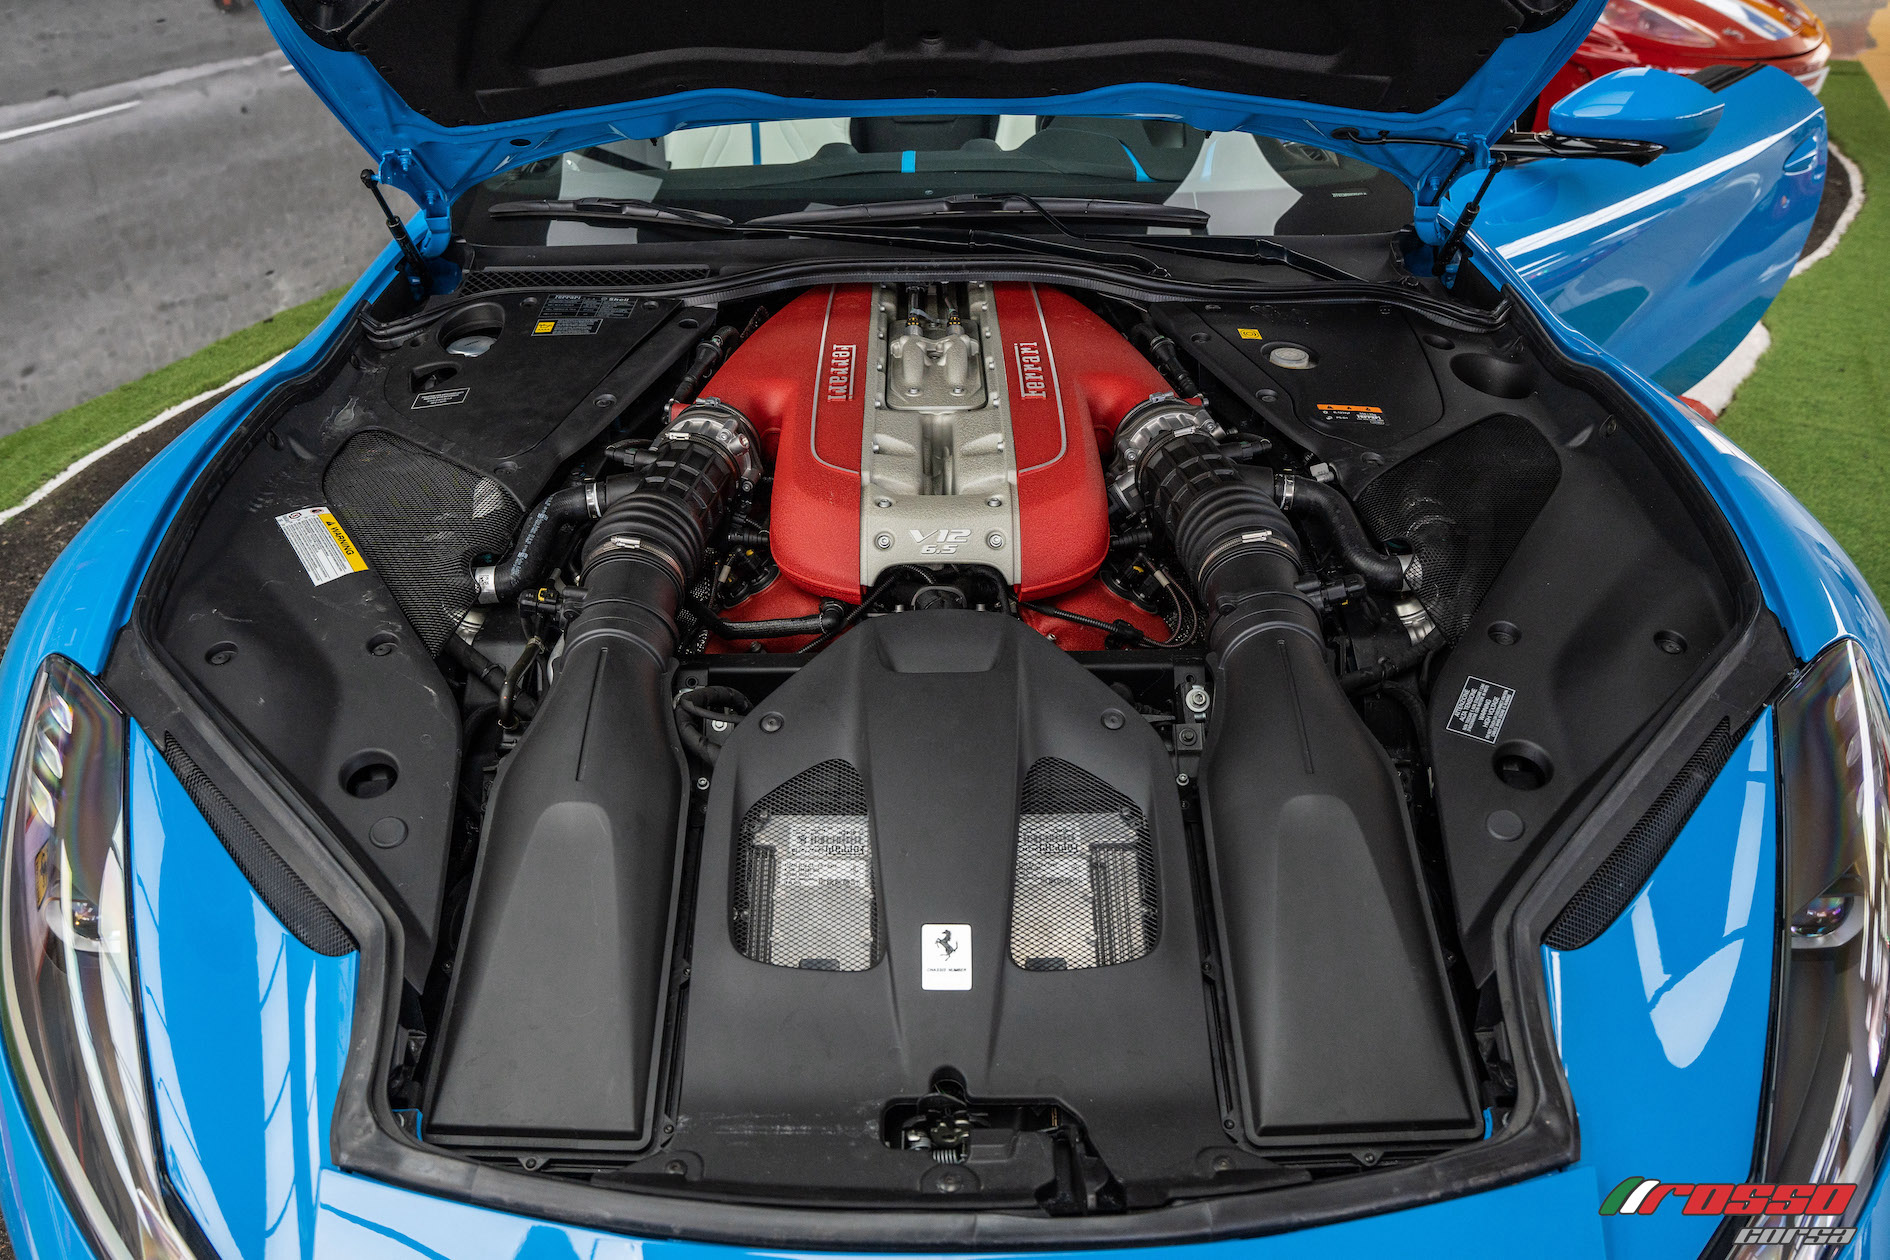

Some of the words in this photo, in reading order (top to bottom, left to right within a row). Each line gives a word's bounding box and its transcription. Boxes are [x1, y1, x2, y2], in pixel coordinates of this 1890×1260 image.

[827, 344, 857, 401] Ferrari
[1013, 342, 1047, 400] Ferrari
[331, 526, 355, 556] WARNING
[908, 528, 972, 544] V12
[920, 544, 959, 555] 6.5
